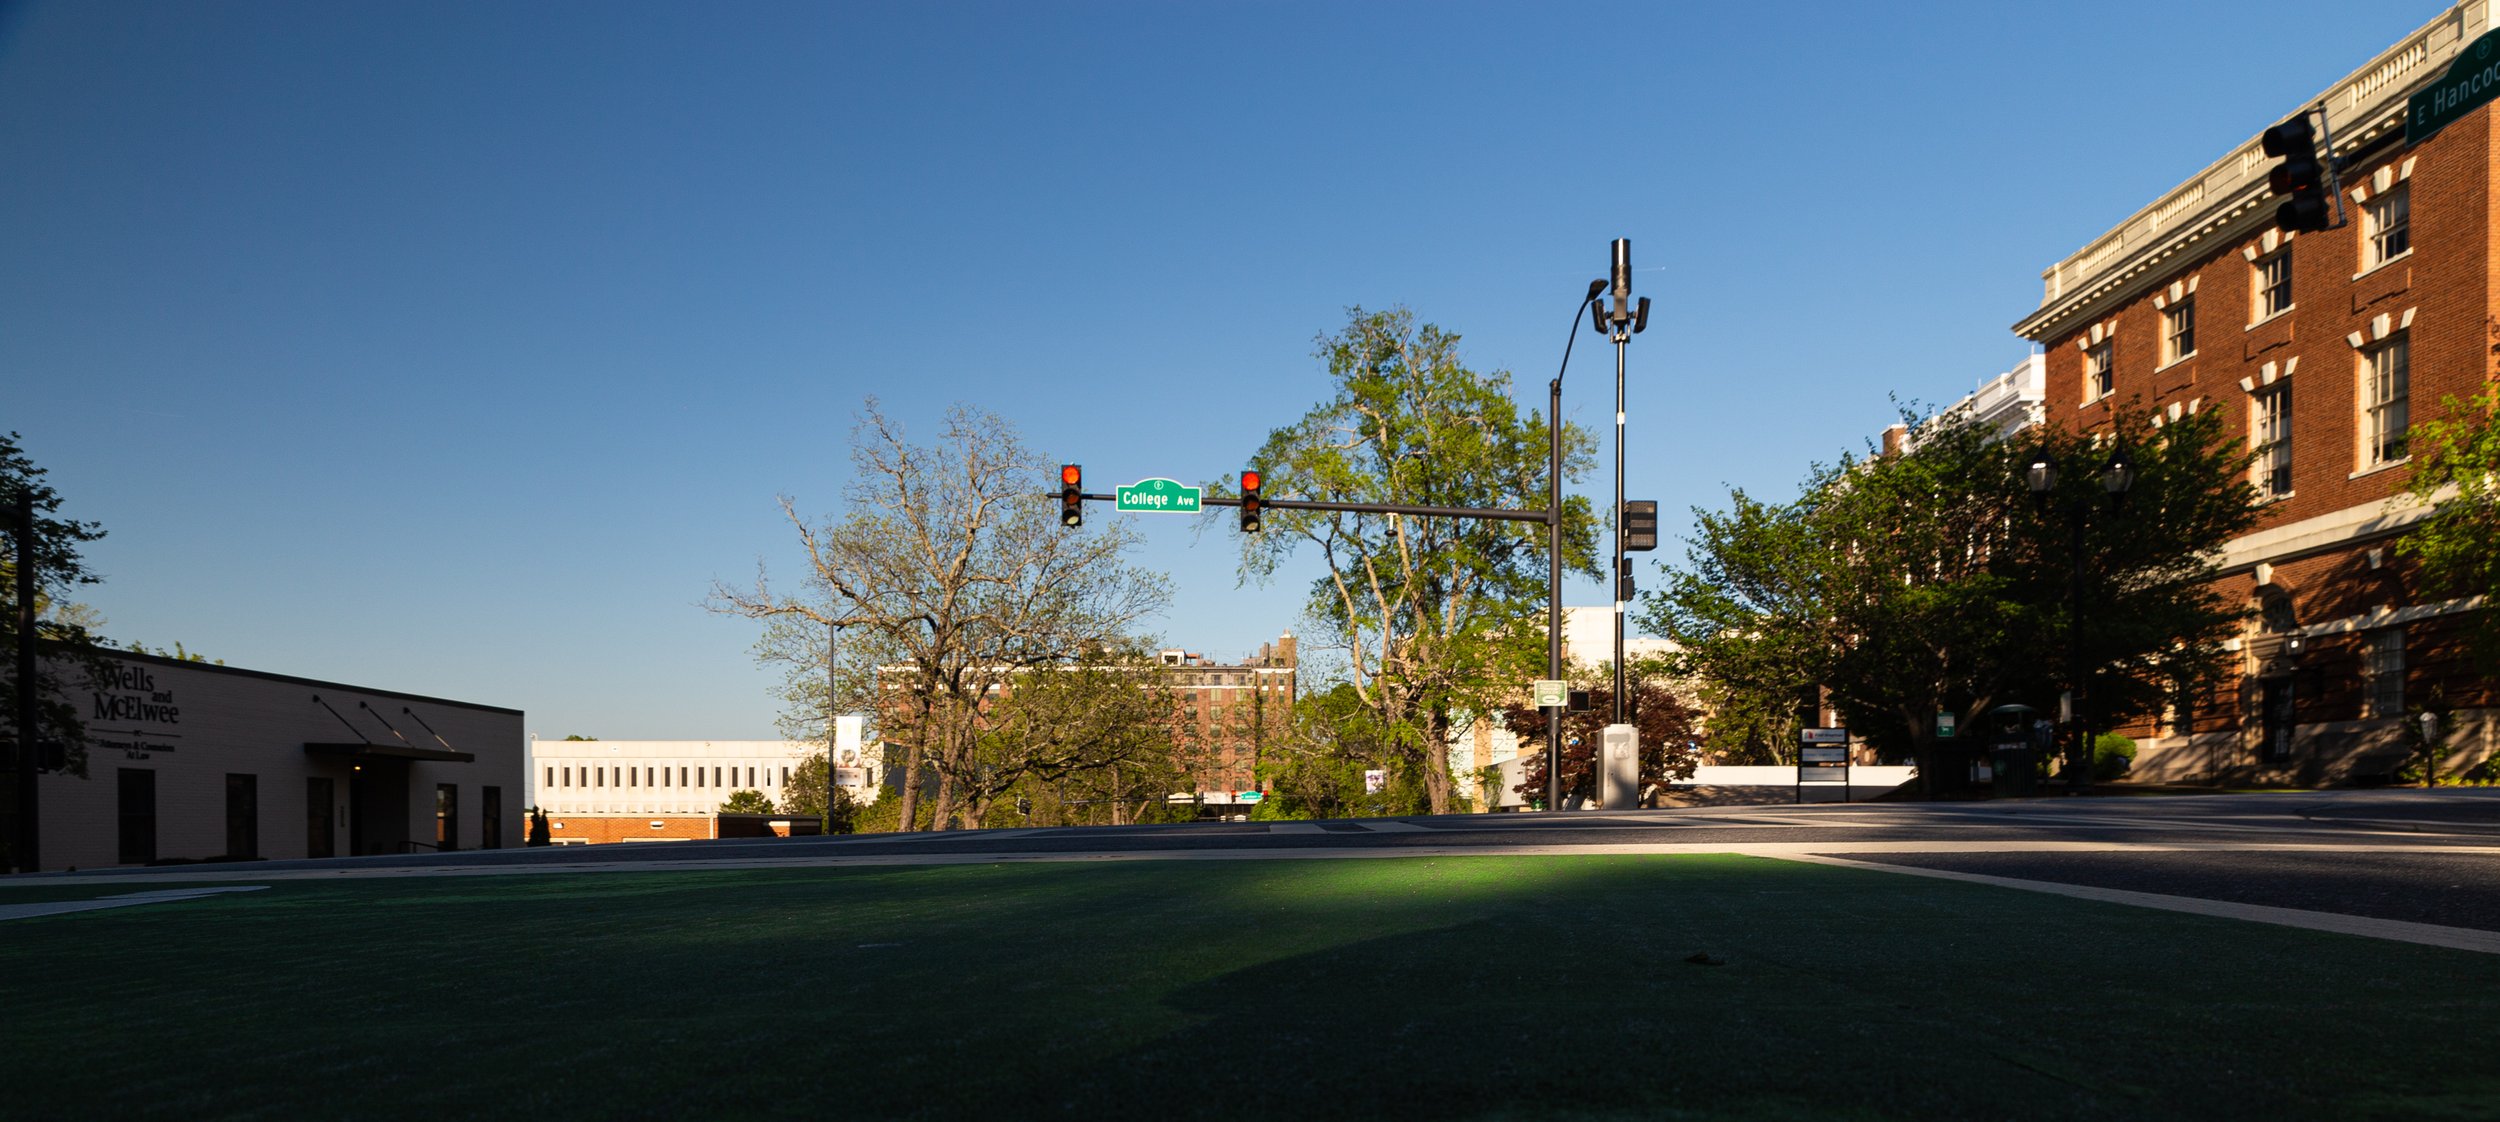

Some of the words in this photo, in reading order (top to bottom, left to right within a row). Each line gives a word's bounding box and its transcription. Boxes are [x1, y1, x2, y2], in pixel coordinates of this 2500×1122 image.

[2417, 104, 2426, 127] E
[1123, 491, 1168, 509] College
[1177, 495, 1194, 506] Ave
[99, 664, 154, 692] Wells
[94, 692, 179, 723] McElwee
[152, 690, 172, 703] and
